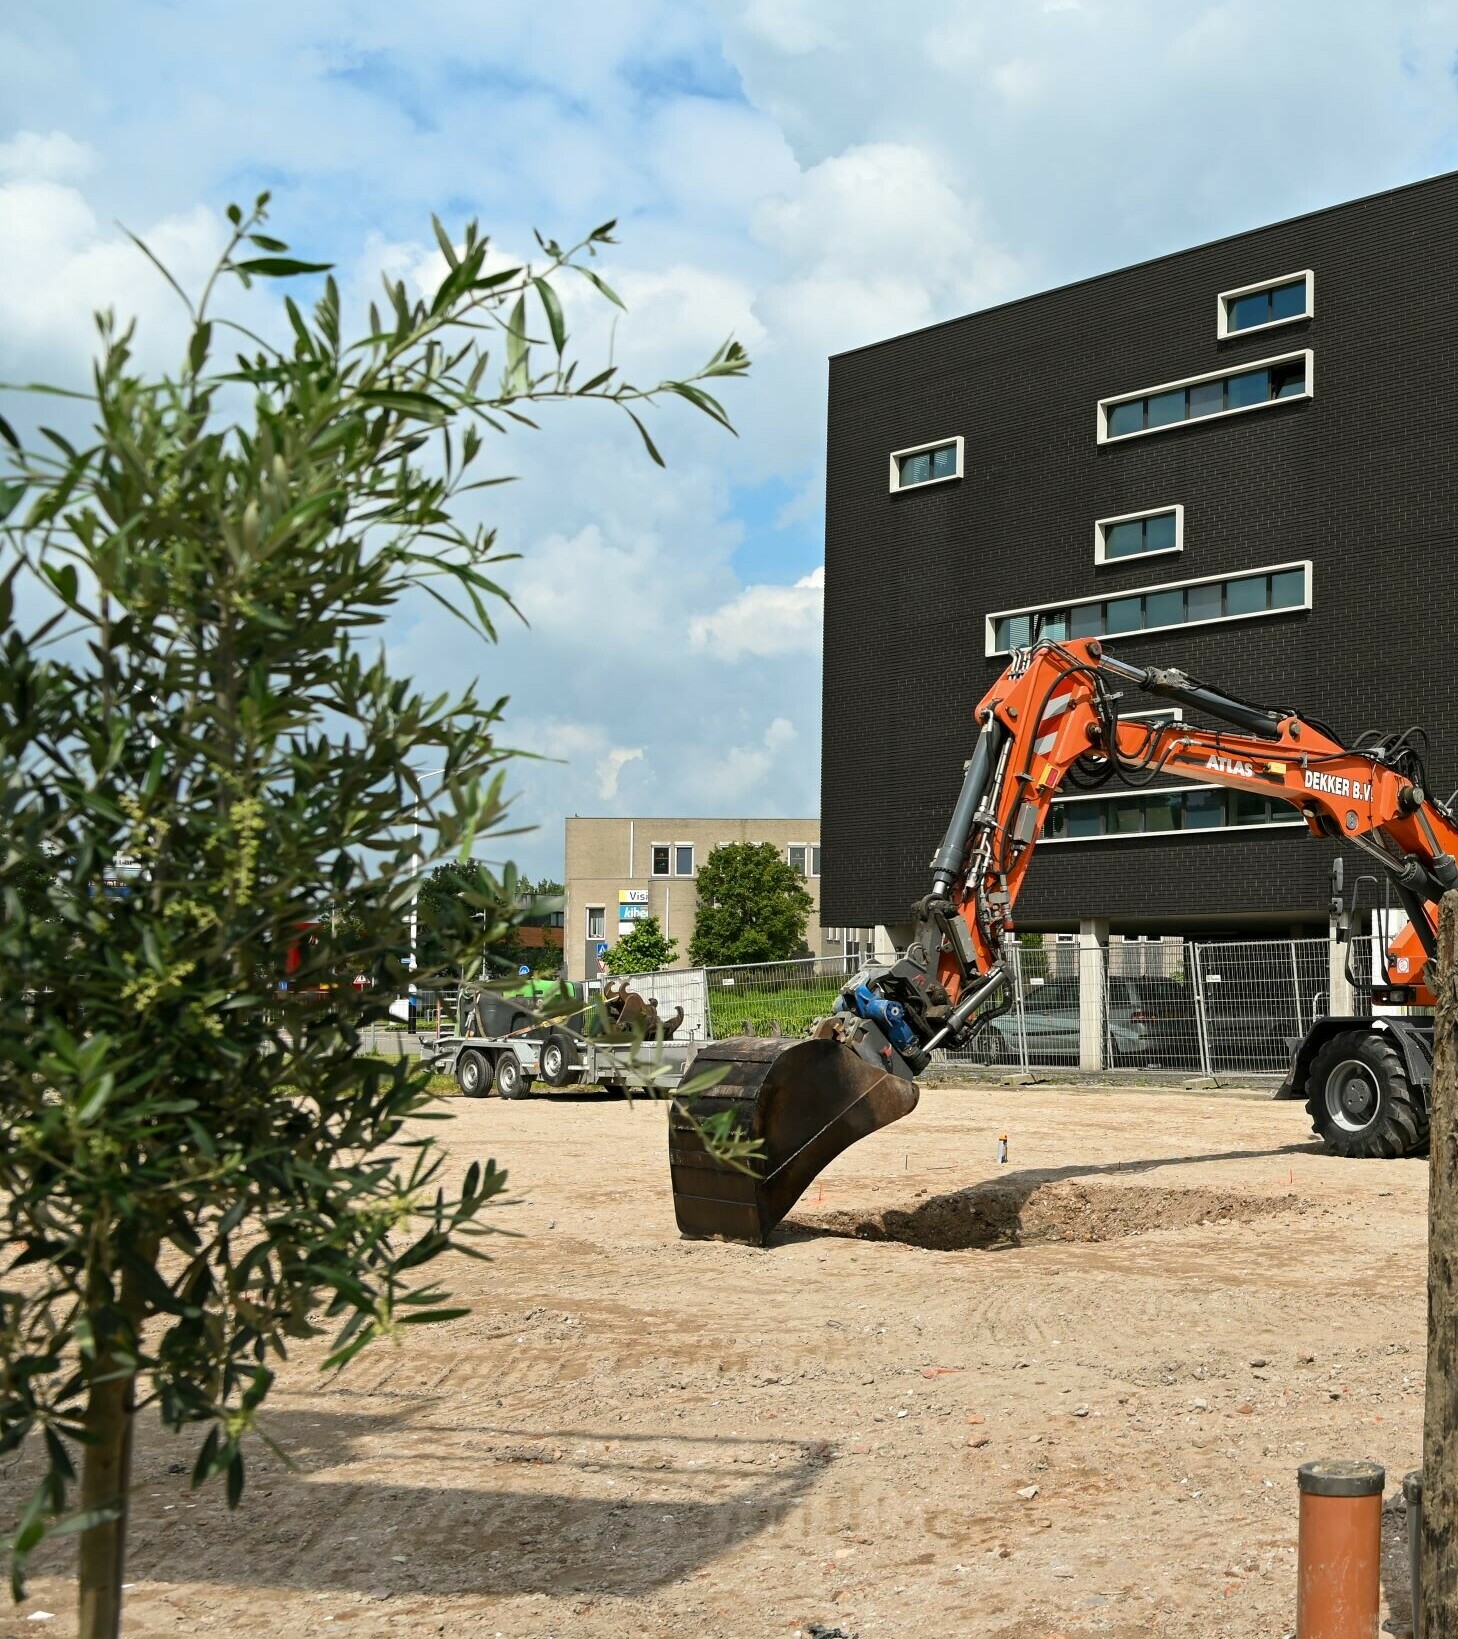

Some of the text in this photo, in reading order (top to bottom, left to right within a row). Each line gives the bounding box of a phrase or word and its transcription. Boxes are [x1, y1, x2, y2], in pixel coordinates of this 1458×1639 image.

[1206, 755, 1254, 777] ATLAS
[1304, 769, 1350, 798] DEKKER
[624, 907, 648, 918] kibe
